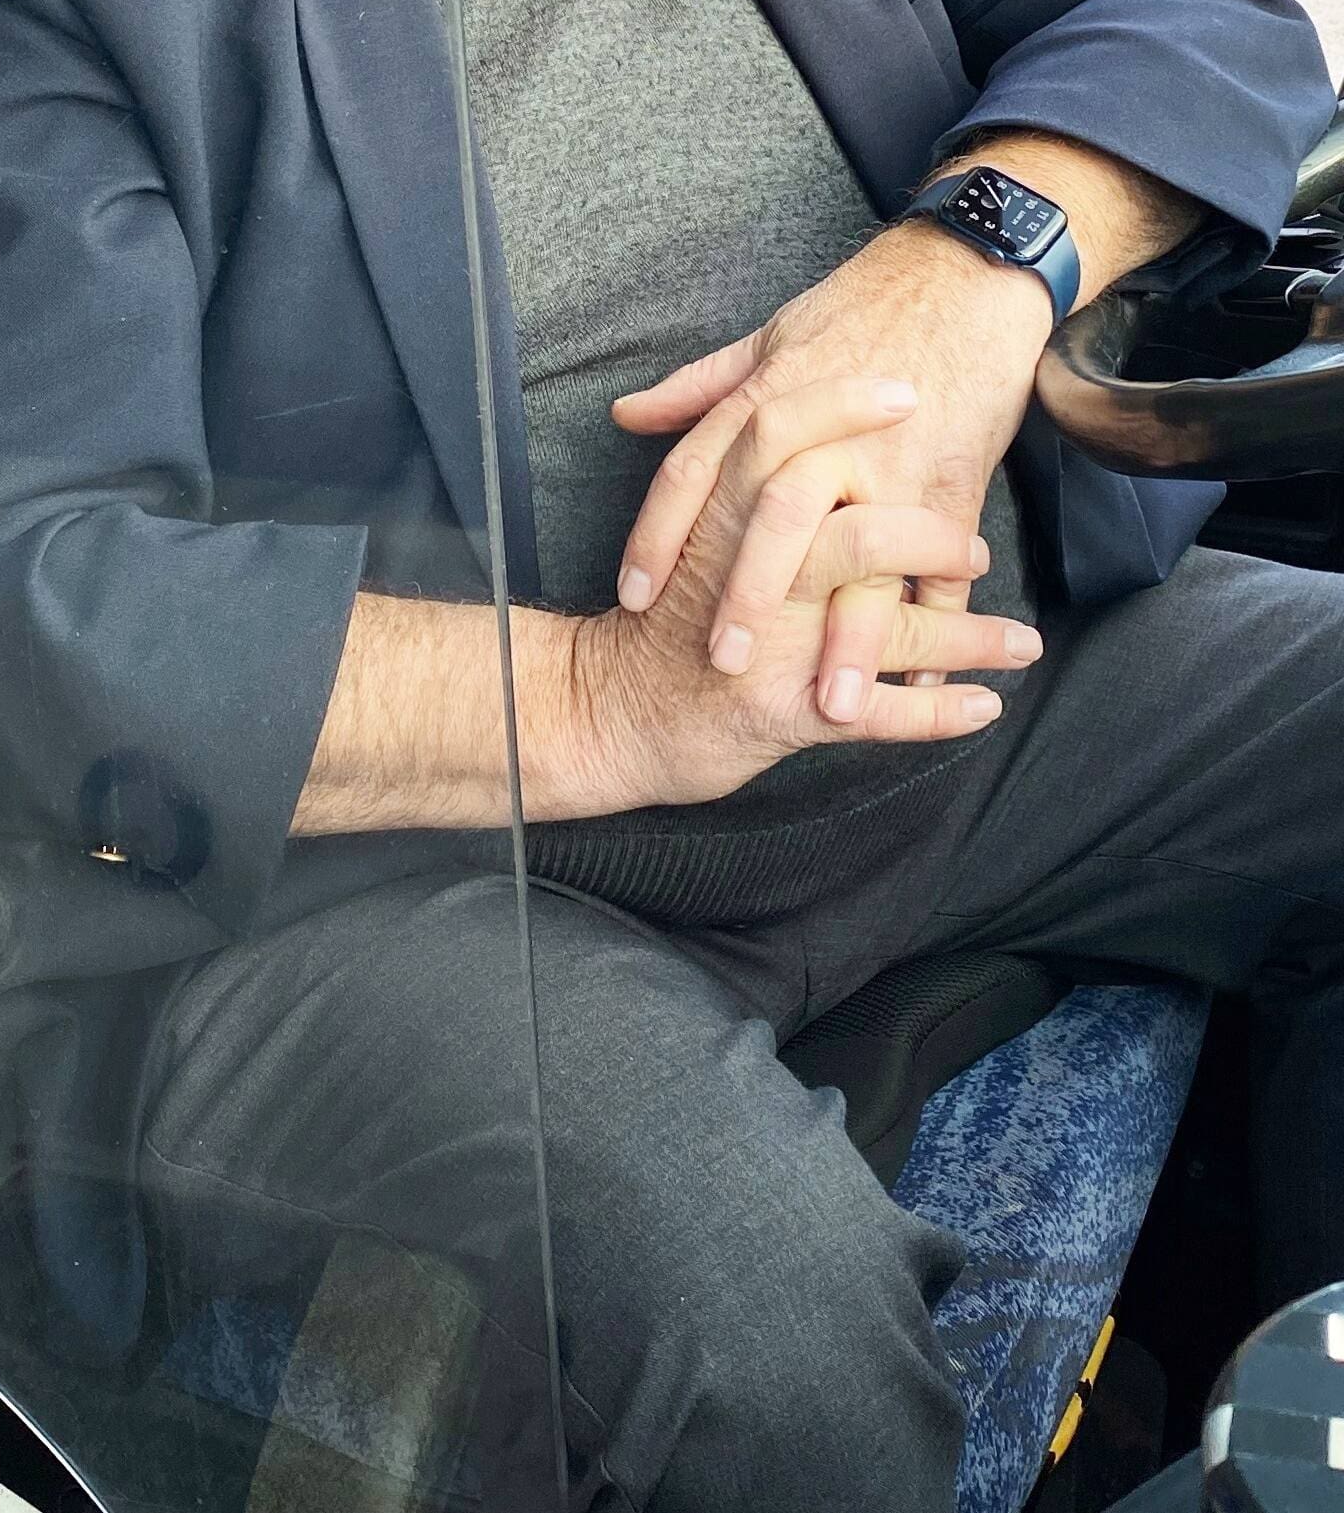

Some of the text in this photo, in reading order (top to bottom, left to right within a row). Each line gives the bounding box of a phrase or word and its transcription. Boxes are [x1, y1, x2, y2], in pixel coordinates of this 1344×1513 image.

[996, 181, 1007, 189] 8
[968, 188, 979, 197] 6
[1013, 190, 1023, 198] 9
[958, 199, 969, 208] 5
[1024, 198, 1038, 209] 10
[968, 212, 979, 221] 4
[1036, 210, 1049, 221] 11
[984, 220, 996, 229] 3
[1026, 221, 1040, 232] 12
